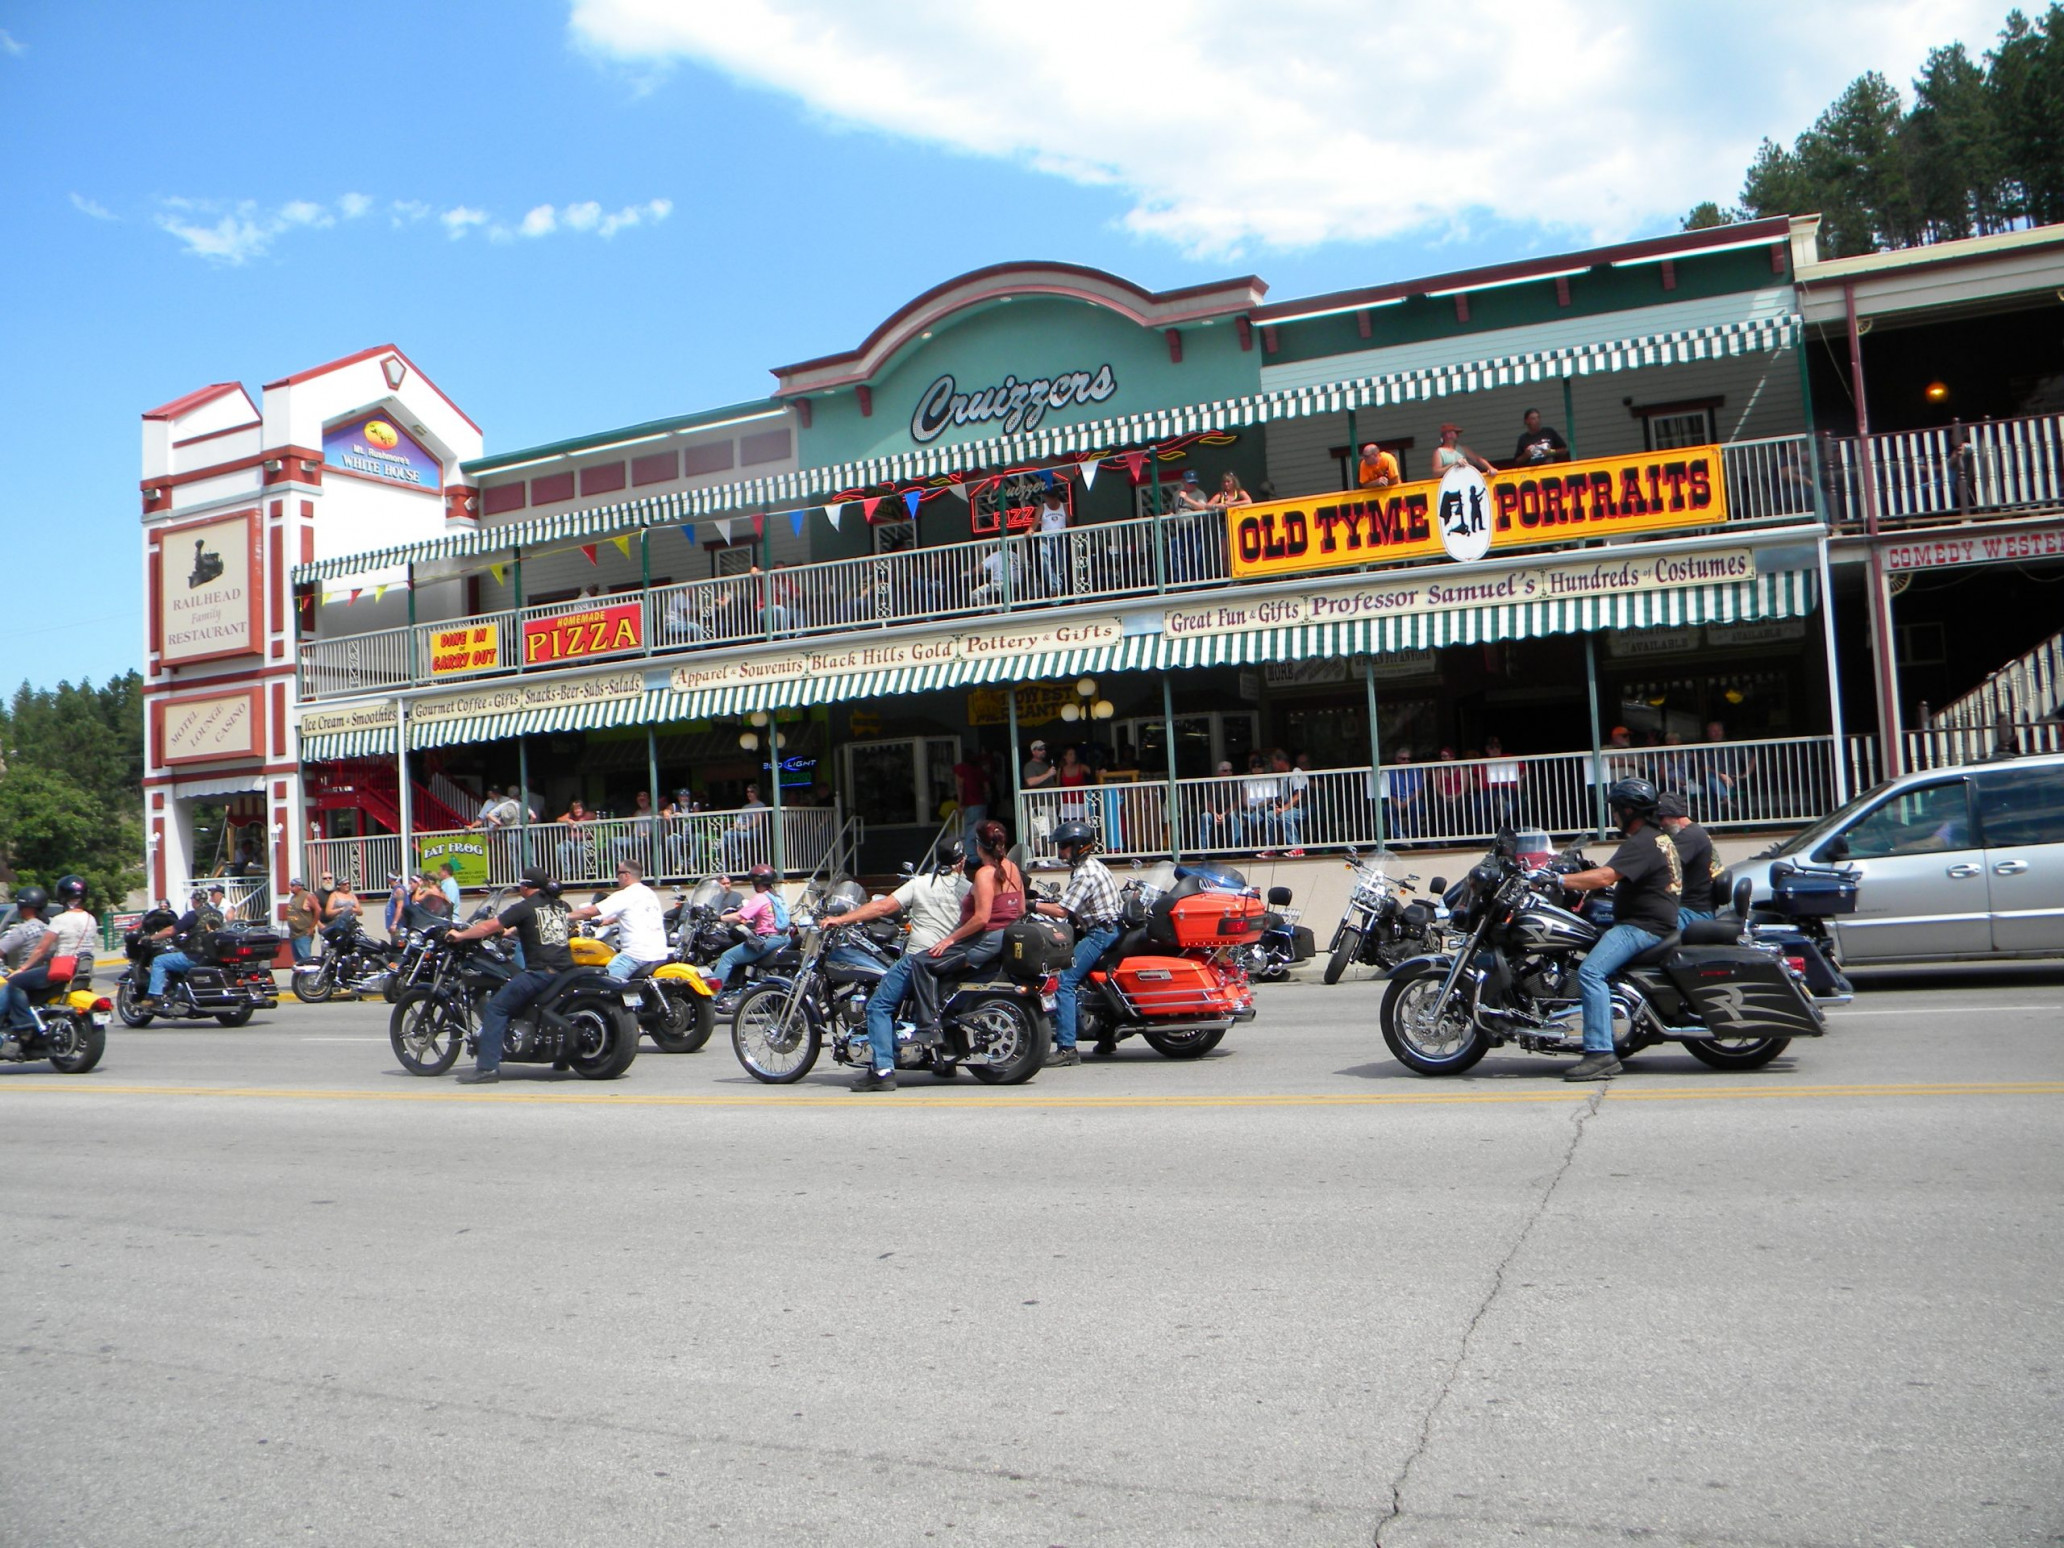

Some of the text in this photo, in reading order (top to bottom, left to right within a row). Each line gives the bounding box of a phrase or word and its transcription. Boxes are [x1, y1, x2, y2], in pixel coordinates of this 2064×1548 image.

[911, 364, 1118, 443] Cruizzers
[342, 454, 420, 483] WHITE HOUSE
[368, 448, 410, 466] Rushmore's
[1239, 458, 1711, 563] OLD TYME PORTRAITS
[1889, 541, 1973, 568] COMEDY
[1550, 564, 1639, 593] Hundreds
[1655, 553, 1747, 582] Costumes
[173, 588, 241, 611] RAILHEAD
[1312, 573, 1536, 616] Professor Samuel's
[191, 605, 222, 624] Family
[557, 611, 605, 627] HOMEMADE
[1171, 609, 1213, 633] Great
[1218, 607, 1247, 627] Fun
[1258, 600, 1299, 623] Gifts
[168, 621, 247, 645] RESTAURANT
[440, 628, 487, 648] DINE IN
[526, 617, 639, 663] PIZZA
[966, 635, 1038, 653] Pottery
[1056, 625, 1112, 641] Gifts
[1631, 638, 1689, 652] AVAILABLE
[432, 648, 497, 672] CARRY OUT
[811, 641, 952, 671] Black Hills Gold
[675, 664, 728, 687] Apparel
[738, 658, 803, 679] Souvenirs
[415, 699, 455, 717] Gourmet
[457, 697, 487, 714] Coffee
[494, 693, 519, 711] Gifts
[170, 711, 200, 746] MOTEL
[190, 704, 224, 747] LOUNGE
[215, 702, 246, 743] CASINO
[304, 717, 317, 732] Ice
[318, 714, 344, 730] Cream
[351, 707, 397, 727] Smoothies
[787, 759, 817, 767] LIGHT
[424, 842, 483, 859] FAT FROG
